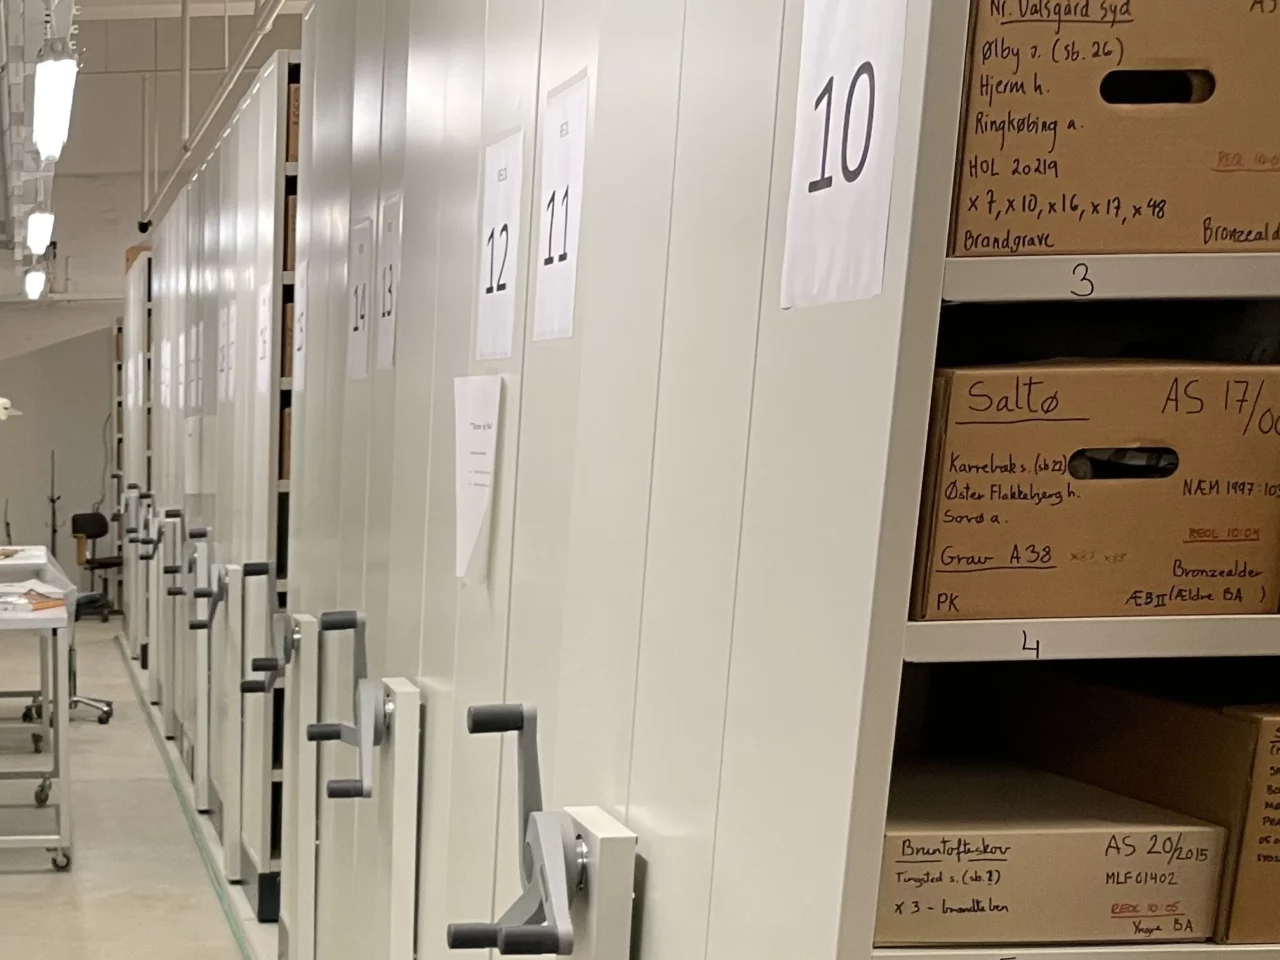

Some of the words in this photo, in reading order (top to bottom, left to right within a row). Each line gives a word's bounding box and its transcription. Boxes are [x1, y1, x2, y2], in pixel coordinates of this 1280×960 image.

[979, 73, 1026, 107] Hjerm
[807, 60, 877, 194] 10
[974, 112, 1058, 153] Ringkøbing
[969, 155, 1000, 178] HOL
[1011, 159, 1059, 178] 20219
[543, 184, 570, 266] 11
[485, 223, 510, 295] 12
[1069, 262, 1095, 297] 3
[352, 282, 367, 332] 14
[968, 375, 1060, 415] Saltø
[1161, 376, 1204, 415] AS
[945, 479, 985, 501] Øster
[1173, 559, 1265, 579] Bronzealder
[936, 593, 960, 612] PK
[1022, 630, 1040, 659] 4
[1105, 833, 1137, 857] AS
[1173, 917, 1194, 933] BA
